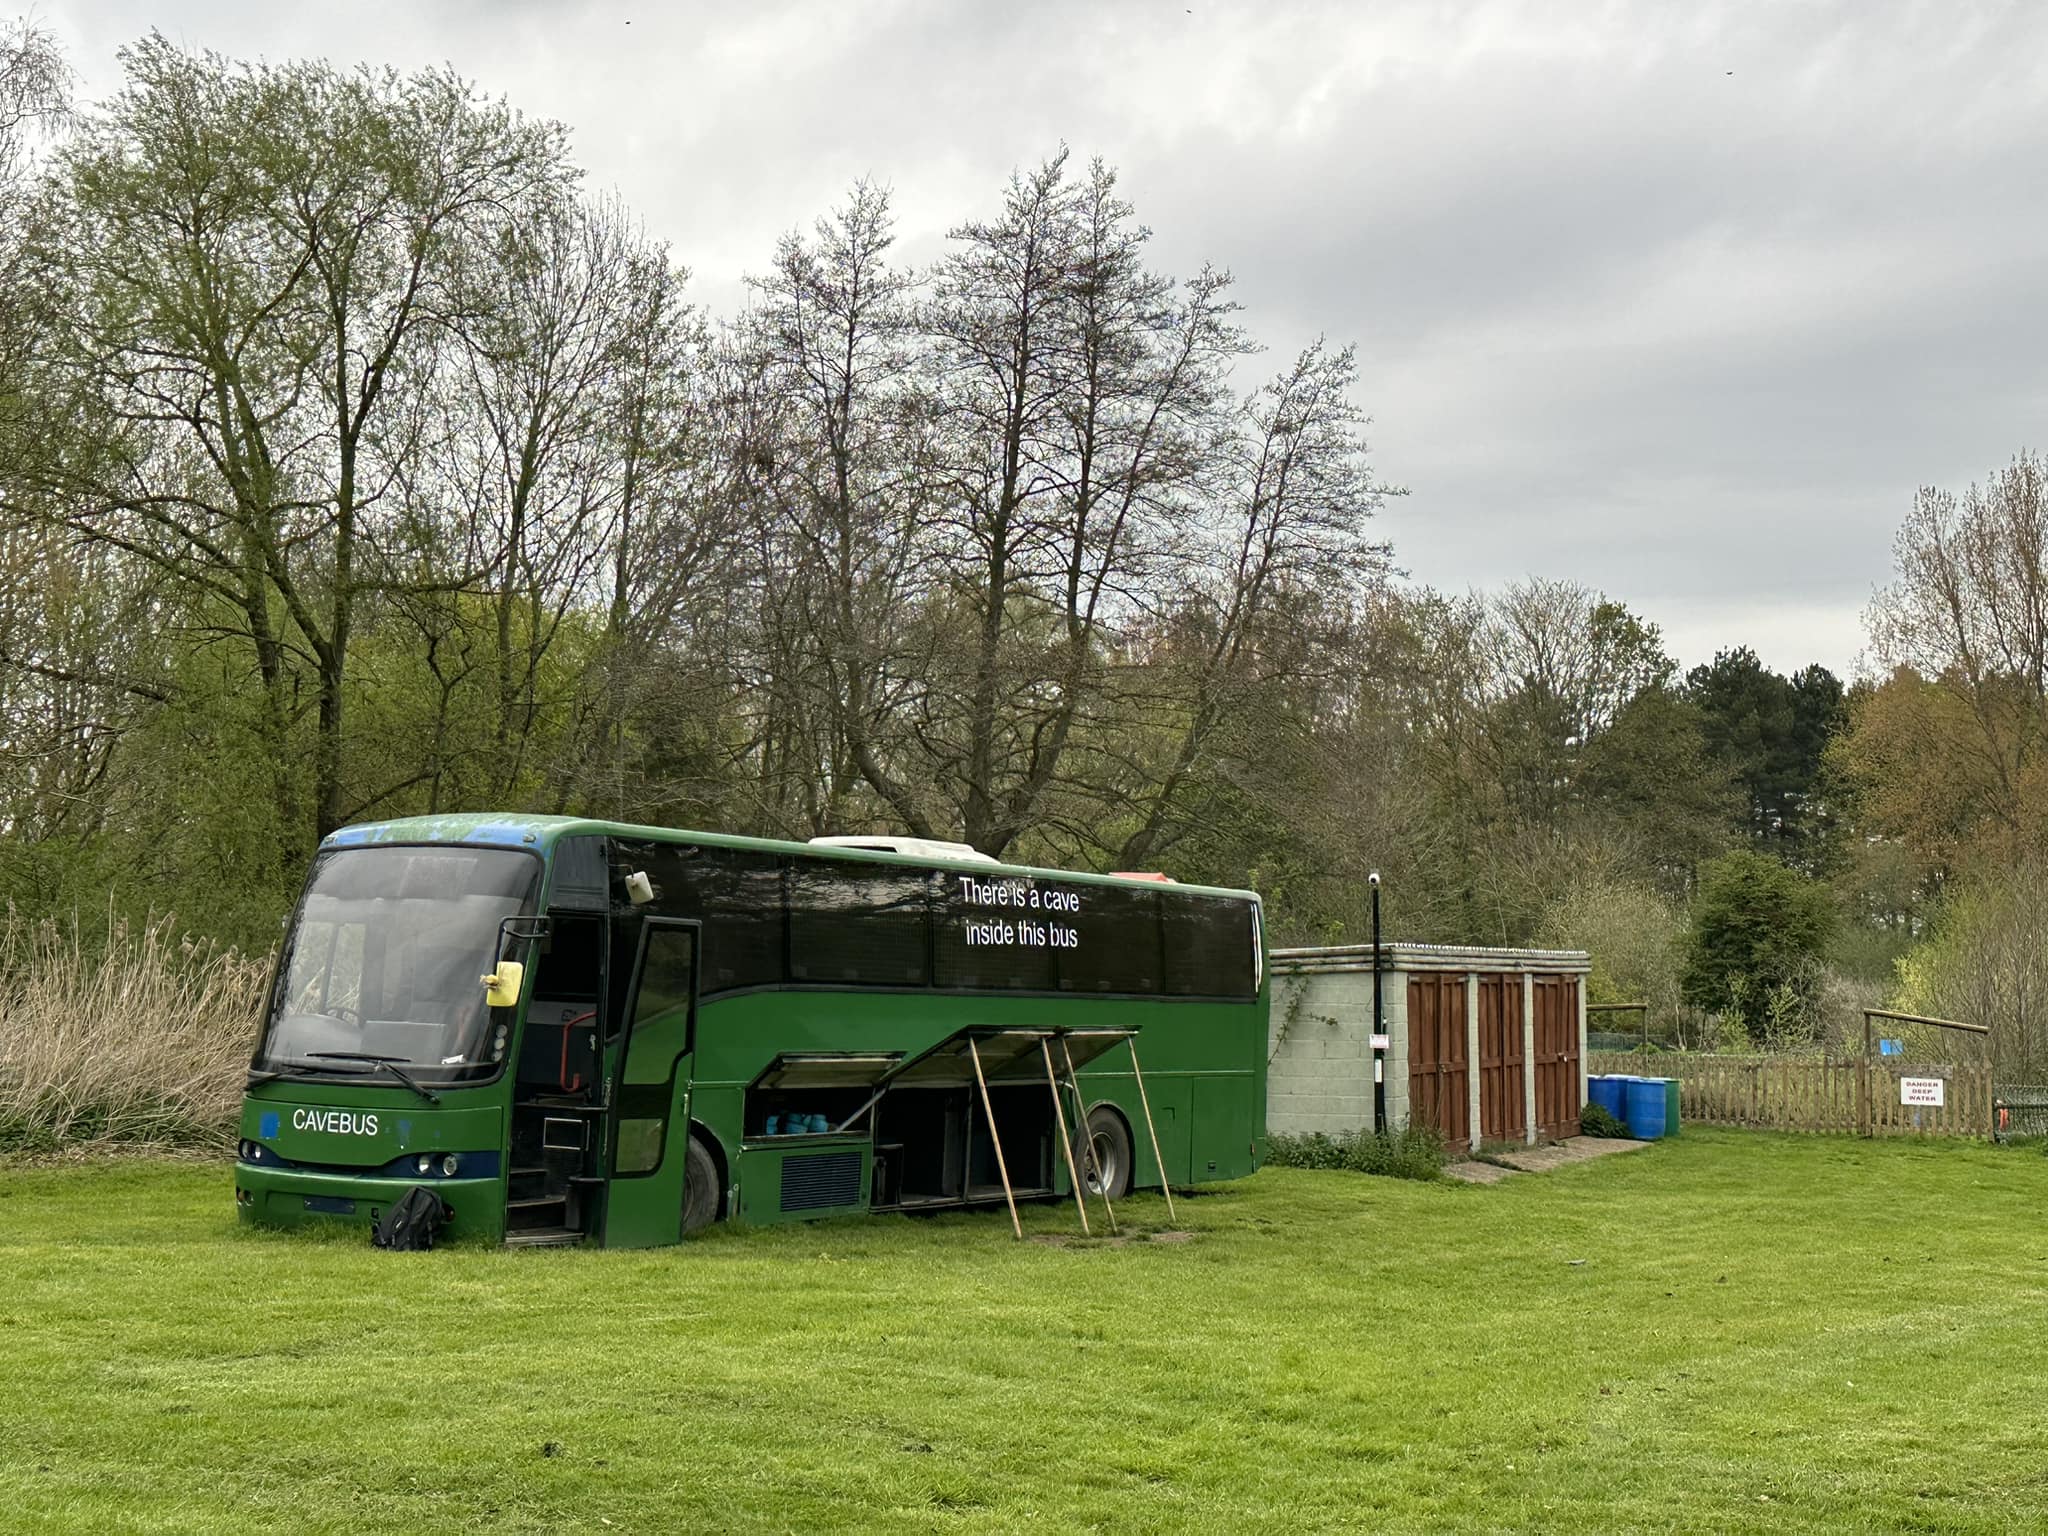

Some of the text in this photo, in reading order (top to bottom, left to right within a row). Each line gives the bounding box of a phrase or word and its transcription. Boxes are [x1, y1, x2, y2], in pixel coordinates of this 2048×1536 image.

[959, 876, 1080, 912] There is a cave
[966, 919, 1078, 948] inside this bus
[293, 1108, 378, 1136] CAVEBUS
